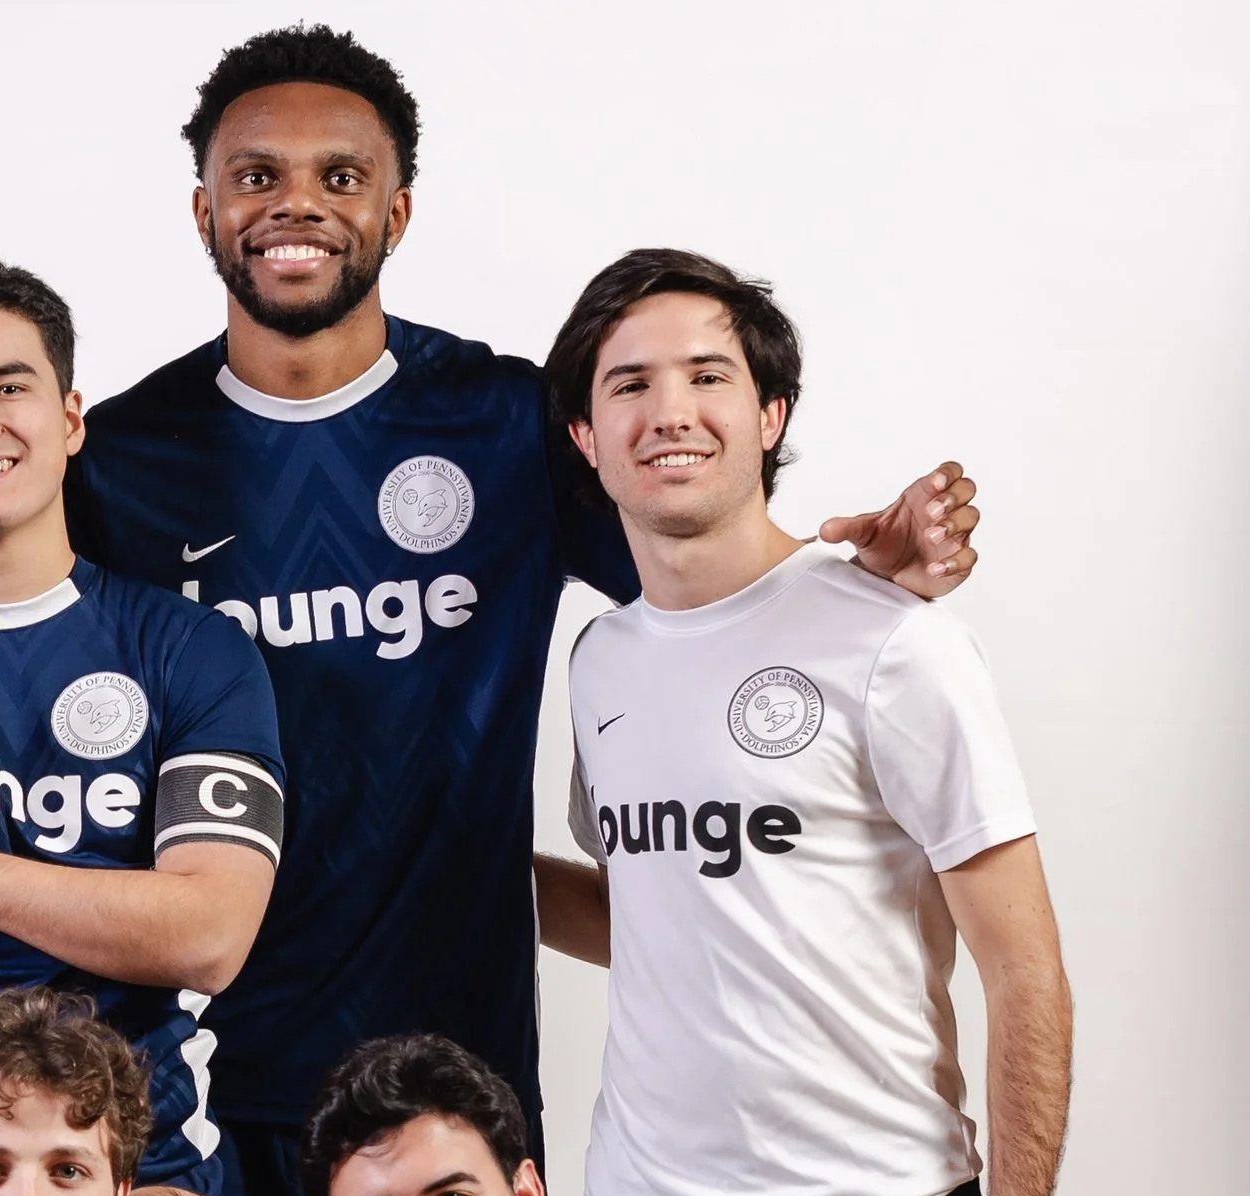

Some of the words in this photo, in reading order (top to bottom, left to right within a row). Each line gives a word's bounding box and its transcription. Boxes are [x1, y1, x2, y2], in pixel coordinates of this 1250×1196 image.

[382, 468, 406, 532] UNIVERSITY
[408, 460, 423, 472] OF
[427, 460, 470, 524] PENNSYLVANIA
[398, 529, 458, 549] DOLPHINOS
[55, 683, 83, 740] UNIVERSITY
[85, 677, 100, 687] OF
[103, 675, 144, 733] PENNSYLVANIA
[732, 675, 765, 732] UNIVERSITY
[767, 671, 781, 681] OF
[783, 672, 819, 737] PENNSYLVANIA
[69, 738, 130, 755] DOLPHINOS
[741, 733, 800, 753] DOLPHINOS
[198, 771, 248, 818] C
[590, 785, 802, 879] ounge
